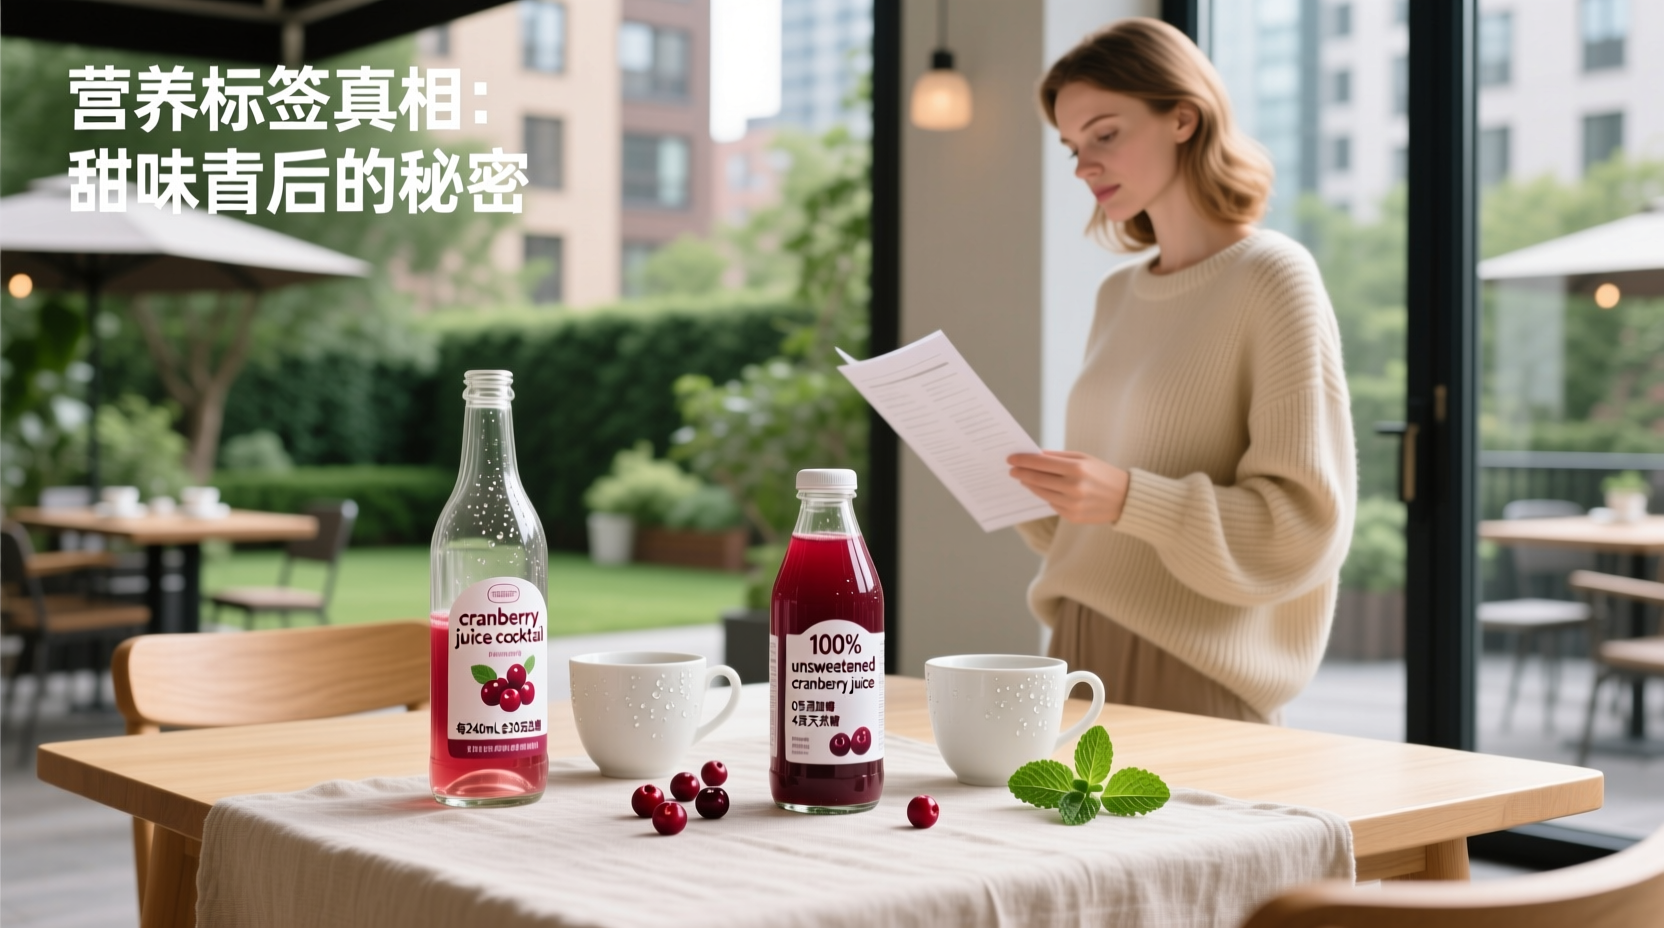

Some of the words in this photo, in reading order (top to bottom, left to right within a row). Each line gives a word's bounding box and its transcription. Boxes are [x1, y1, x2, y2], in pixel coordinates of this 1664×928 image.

[459, 607, 540, 628] cranberry
[454, 628, 493, 649] juice
[809, 633, 862, 655] 100%
[791, 655, 876, 673] unsweetened
[791, 676, 848, 694] cranberry
[848, 676, 875, 694] juice
